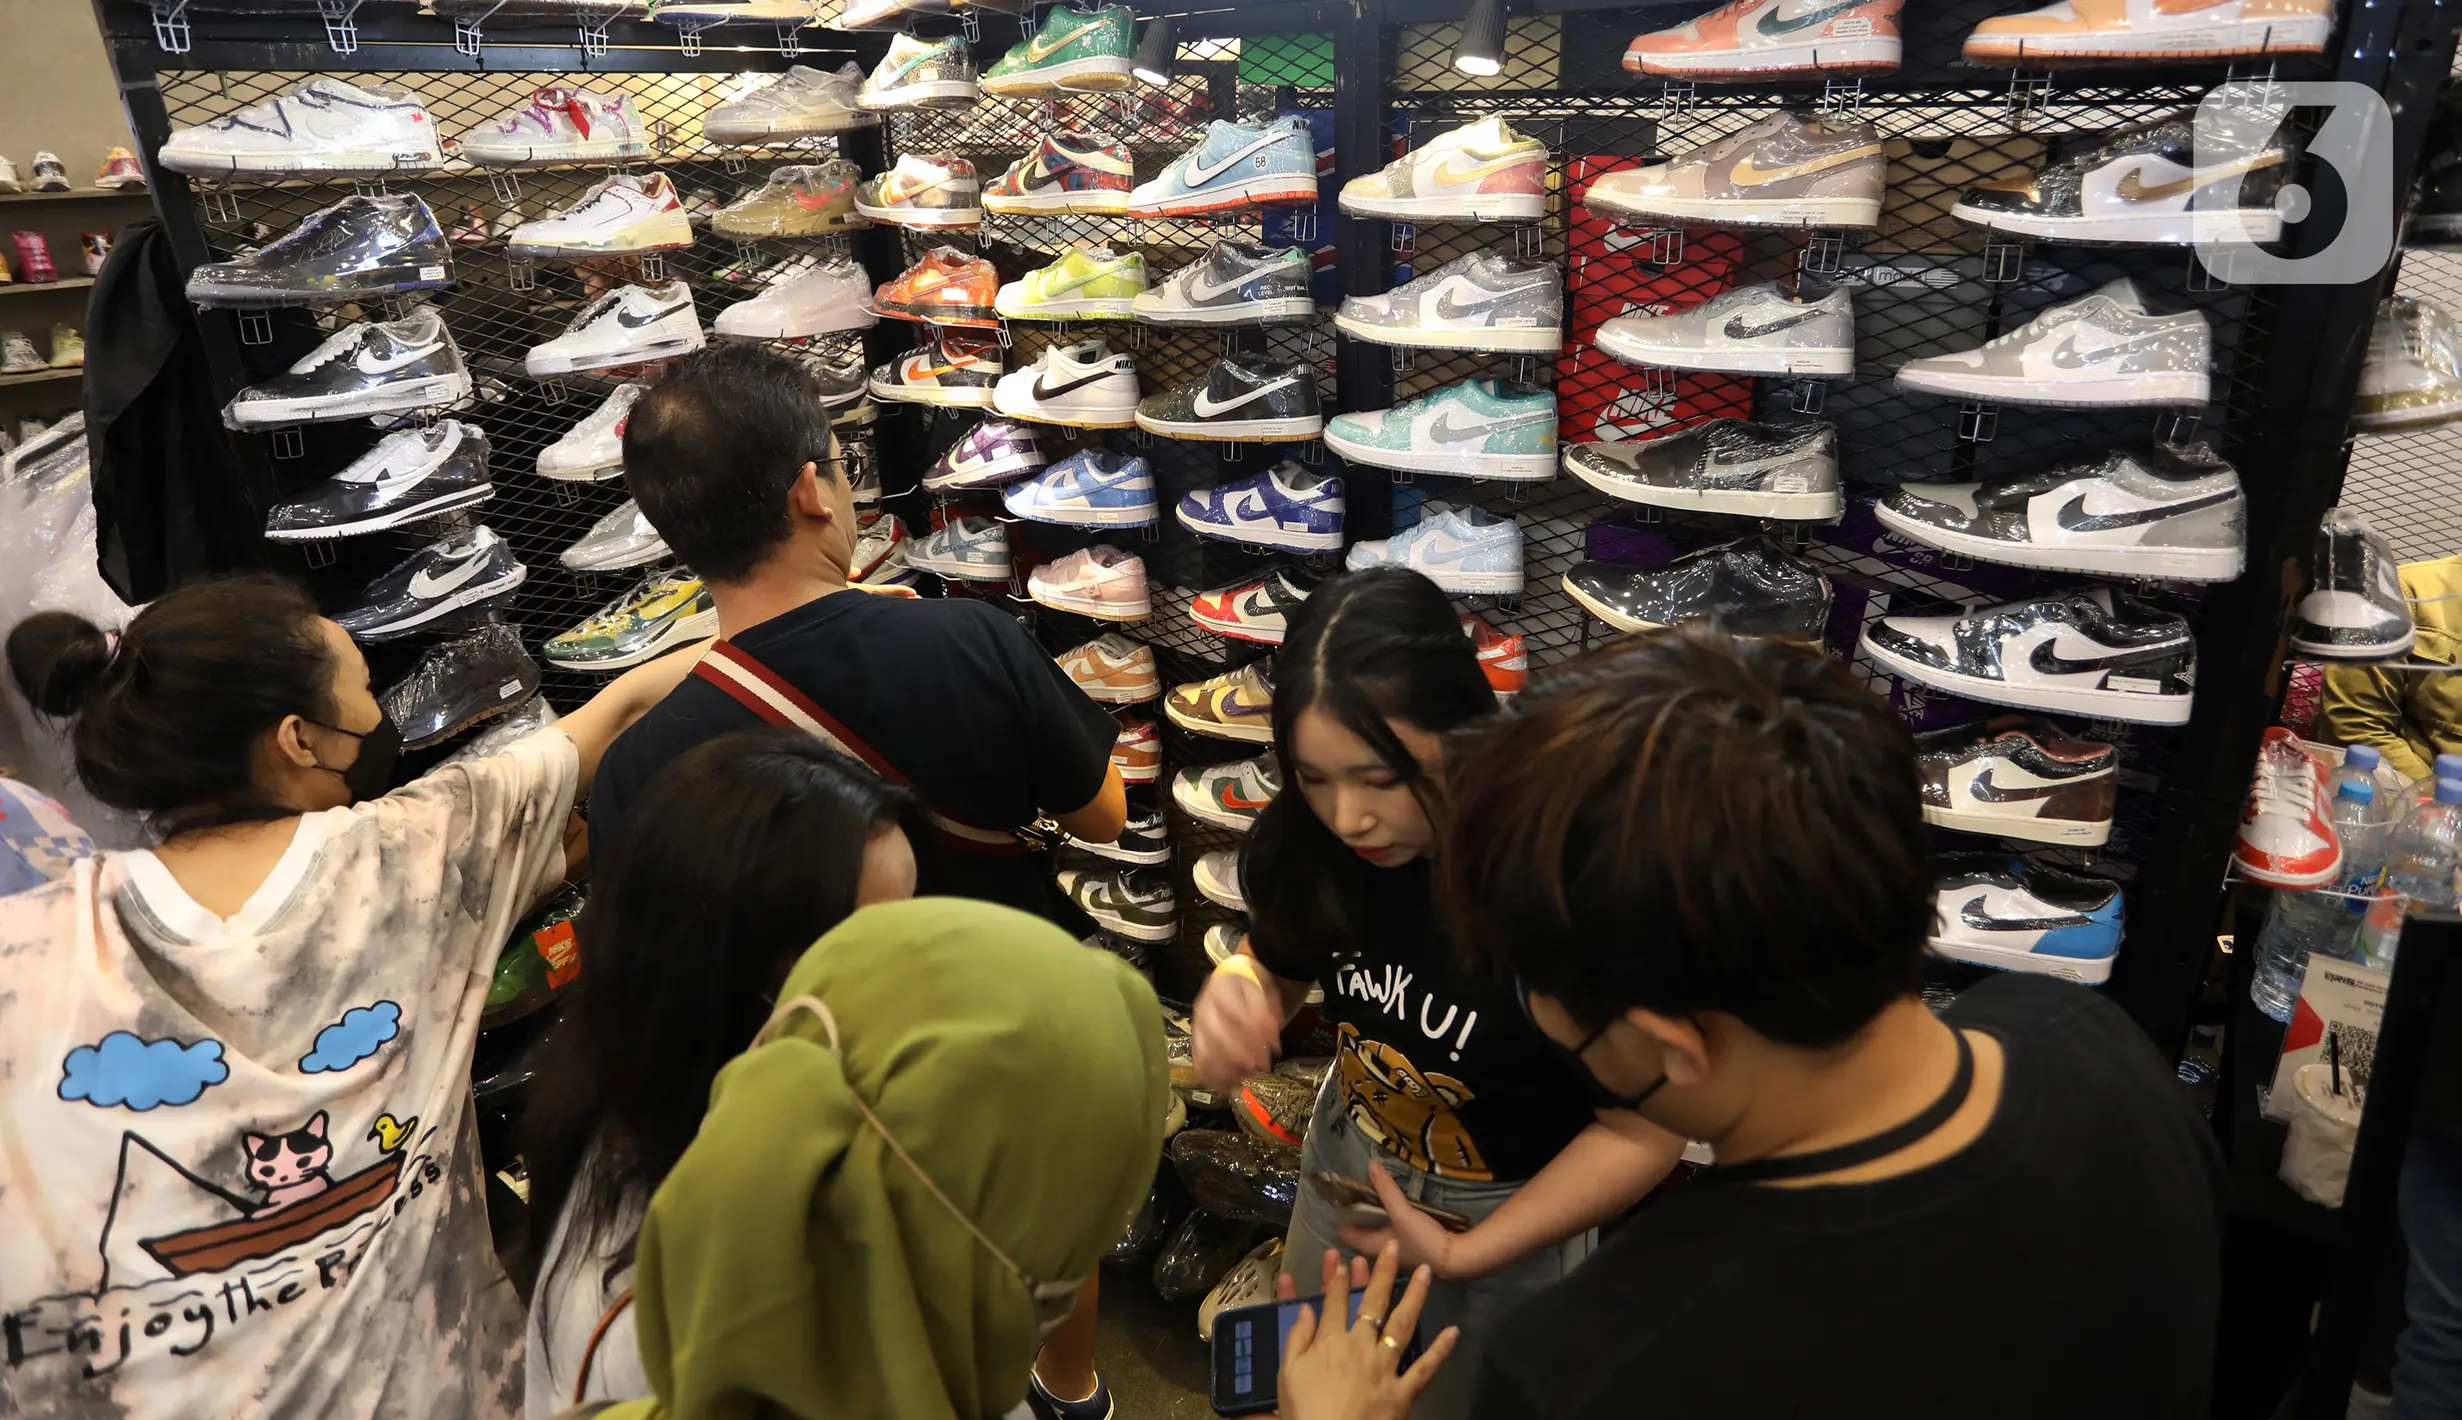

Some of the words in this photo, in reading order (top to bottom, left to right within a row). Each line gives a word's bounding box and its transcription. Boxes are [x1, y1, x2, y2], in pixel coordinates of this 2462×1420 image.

[1255, 155, 1267, 169] 58
[1114, 360, 1134, 370] NIKE
[1609, 387, 1679, 422] NIKE
[1336, 964, 1414, 1021] TAWK
[1420, 992, 1478, 1062] U!
[2, 1300, 216, 1380] Enjoy
[216, 1275, 307, 1326] the
